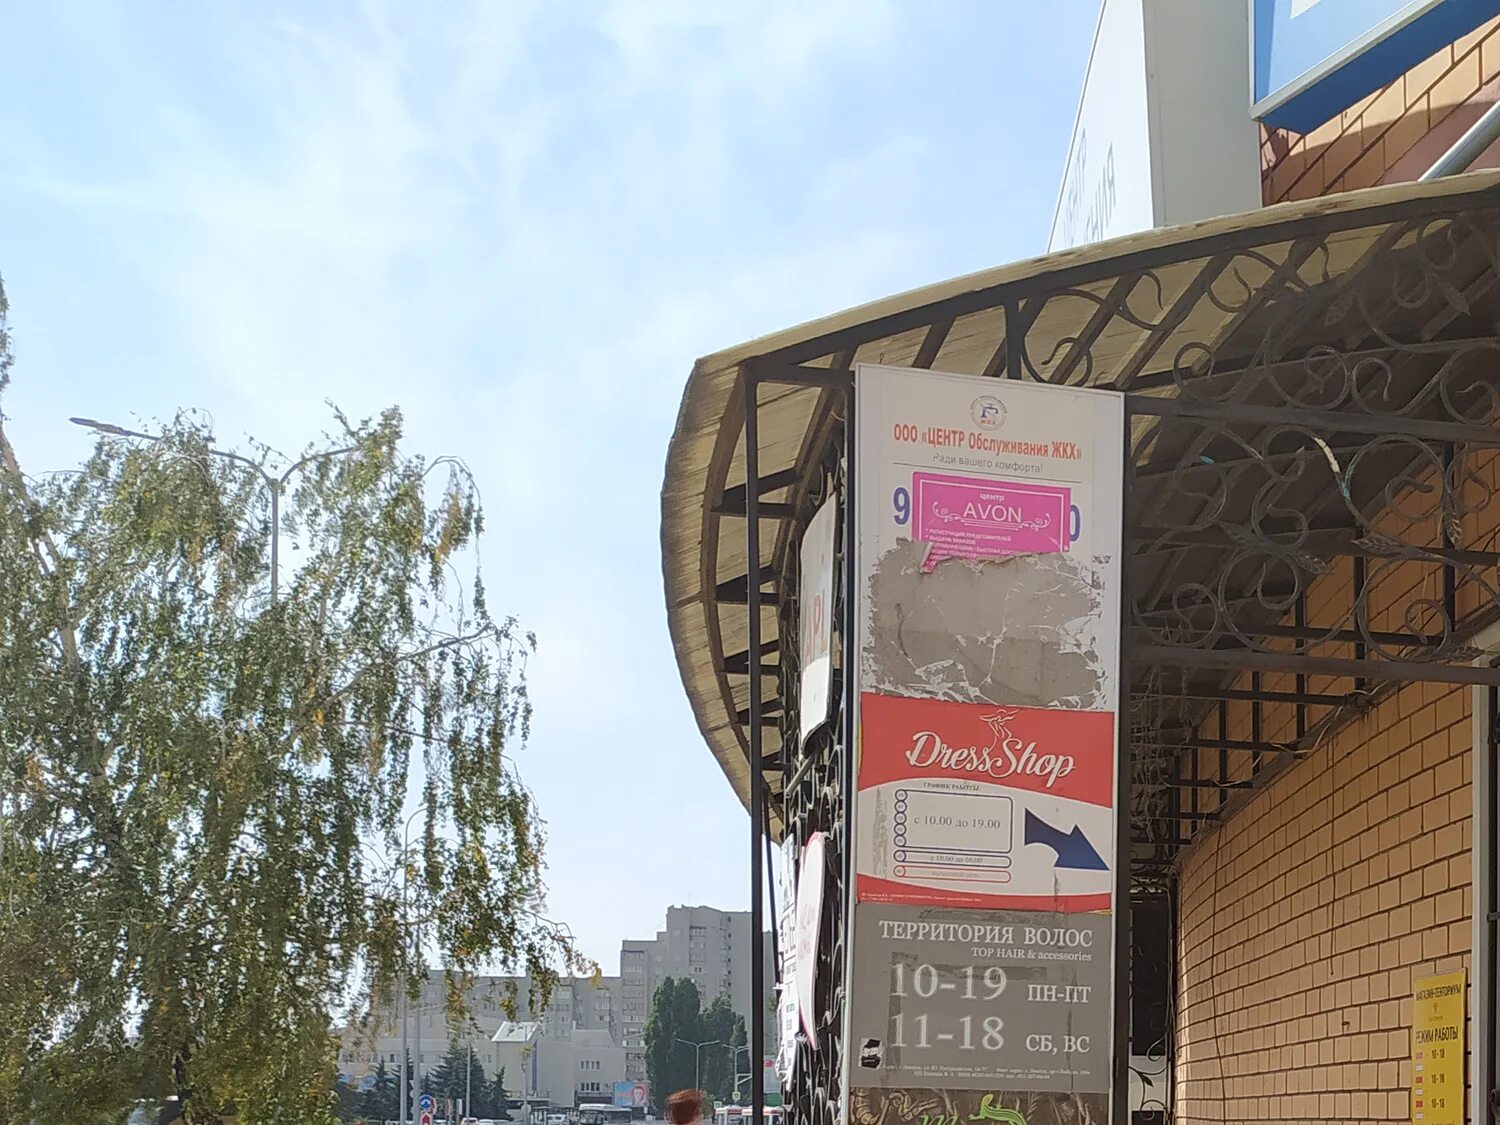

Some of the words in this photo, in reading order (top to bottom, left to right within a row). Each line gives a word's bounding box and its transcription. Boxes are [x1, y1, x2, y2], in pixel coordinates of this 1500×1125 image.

[894, 423, 918, 442] ООО
[968, 432, 1049, 457] Обслуживания
[958, 457, 993, 469] вашего
[980, 493, 1004, 502] центр
[963, 502, 1022, 523] AVON
[906, 731, 991, 773] Dress
[988, 738, 1076, 788] Shop
[924, 815, 952, 826] 10.00
[955, 820, 968, 828] до
[973, 819, 1000, 829] 19.00
[878, 920, 1014, 945] ТЕРРИТОРИЯ
[1024, 927, 1093, 947] ВОЛОС
[971, 947, 994, 958] TOP
[996, 948, 1025, 959] HAIR
[1027, 949, 1036, 959] &
[1037, 951, 1092, 962] accessories
[891, 962, 1007, 1000] 10-19
[1027, 984, 1091, 1003] ПН-ПТ
[890, 1013, 1005, 1051] 11-18
[1434, 1025, 1459, 1042] РАБОТЫ
[1025, 1034, 1058, 1055] СБ,
[1063, 1035, 1091, 1053] ВС
